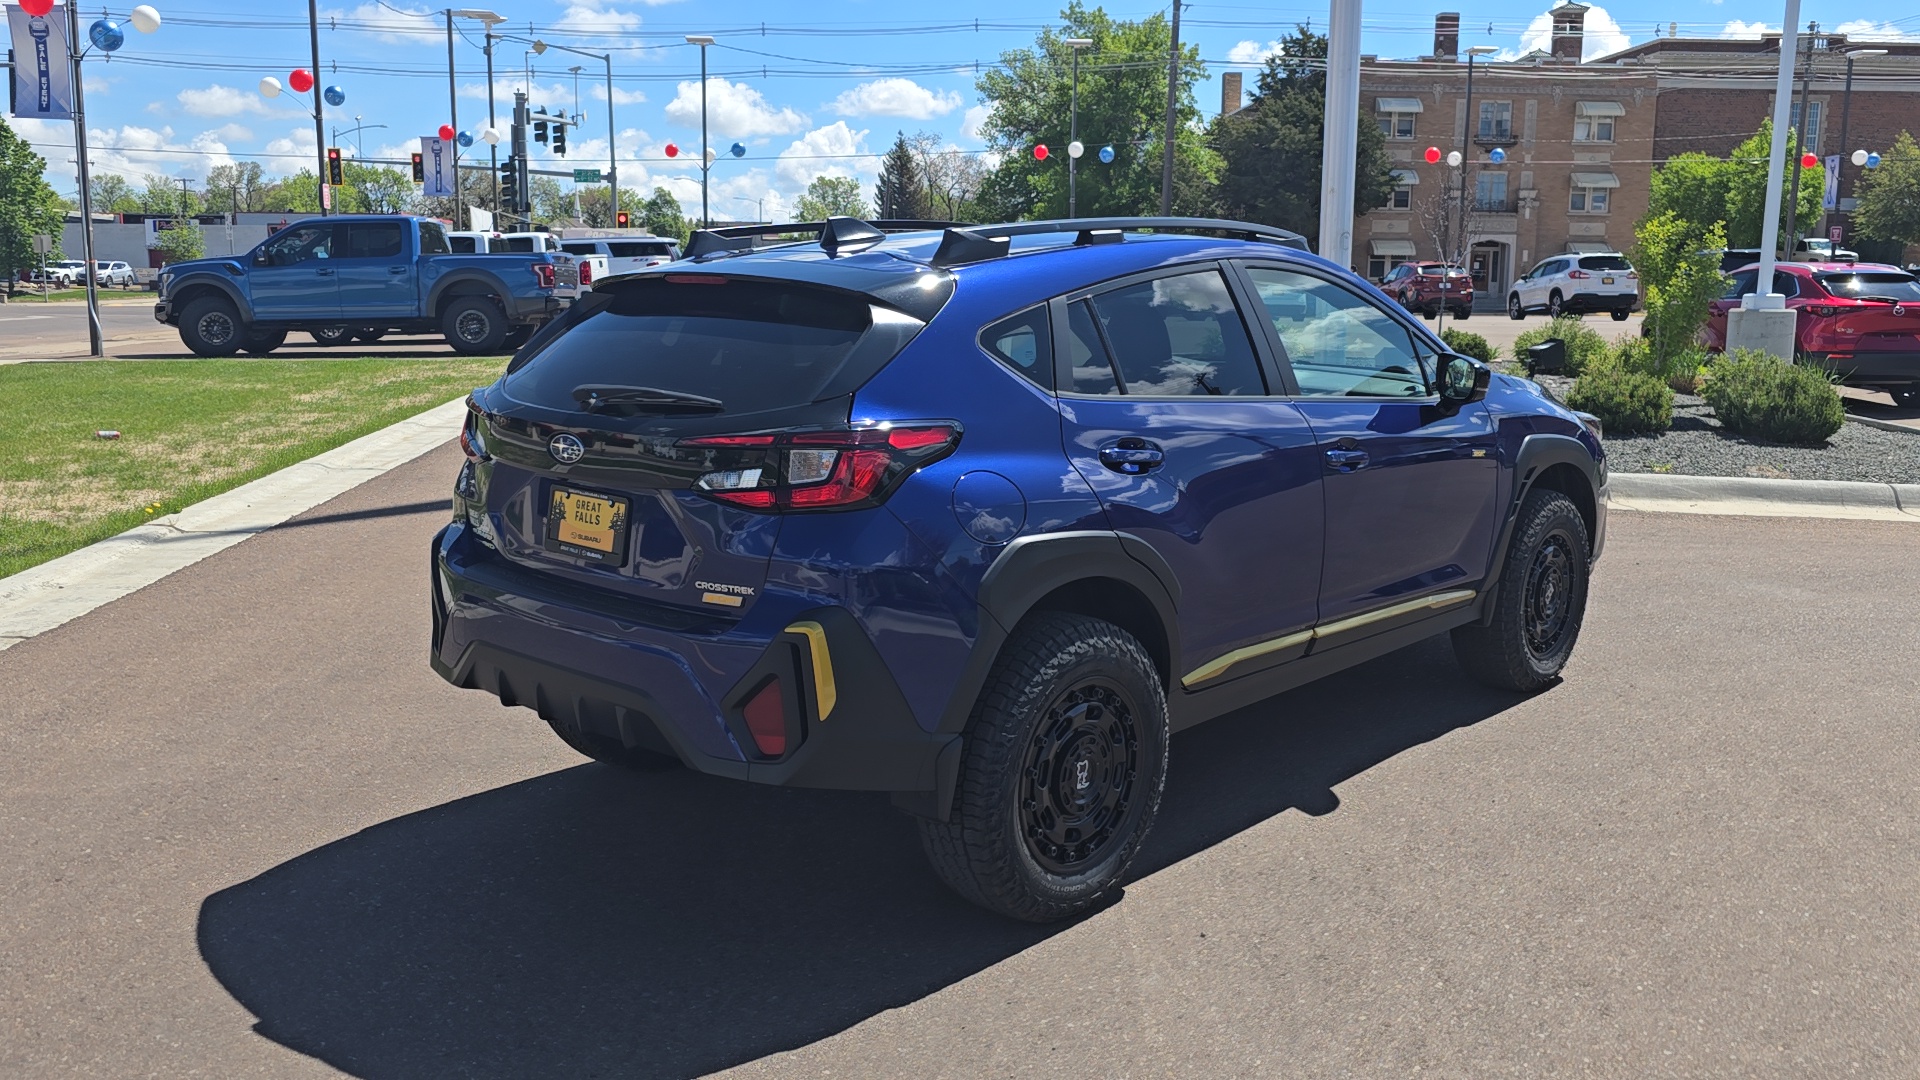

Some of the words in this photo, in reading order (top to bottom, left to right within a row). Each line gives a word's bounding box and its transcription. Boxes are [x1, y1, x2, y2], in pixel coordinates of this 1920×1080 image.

[38, 44, 47, 71] SALE
[40, 77, 48, 108] EVENT
[575, 499, 602, 513] GREAT
[574, 510, 601, 526] FALLS
[577, 533, 601, 544] SUBARU
[694, 580, 755, 596] CROSSTREK
